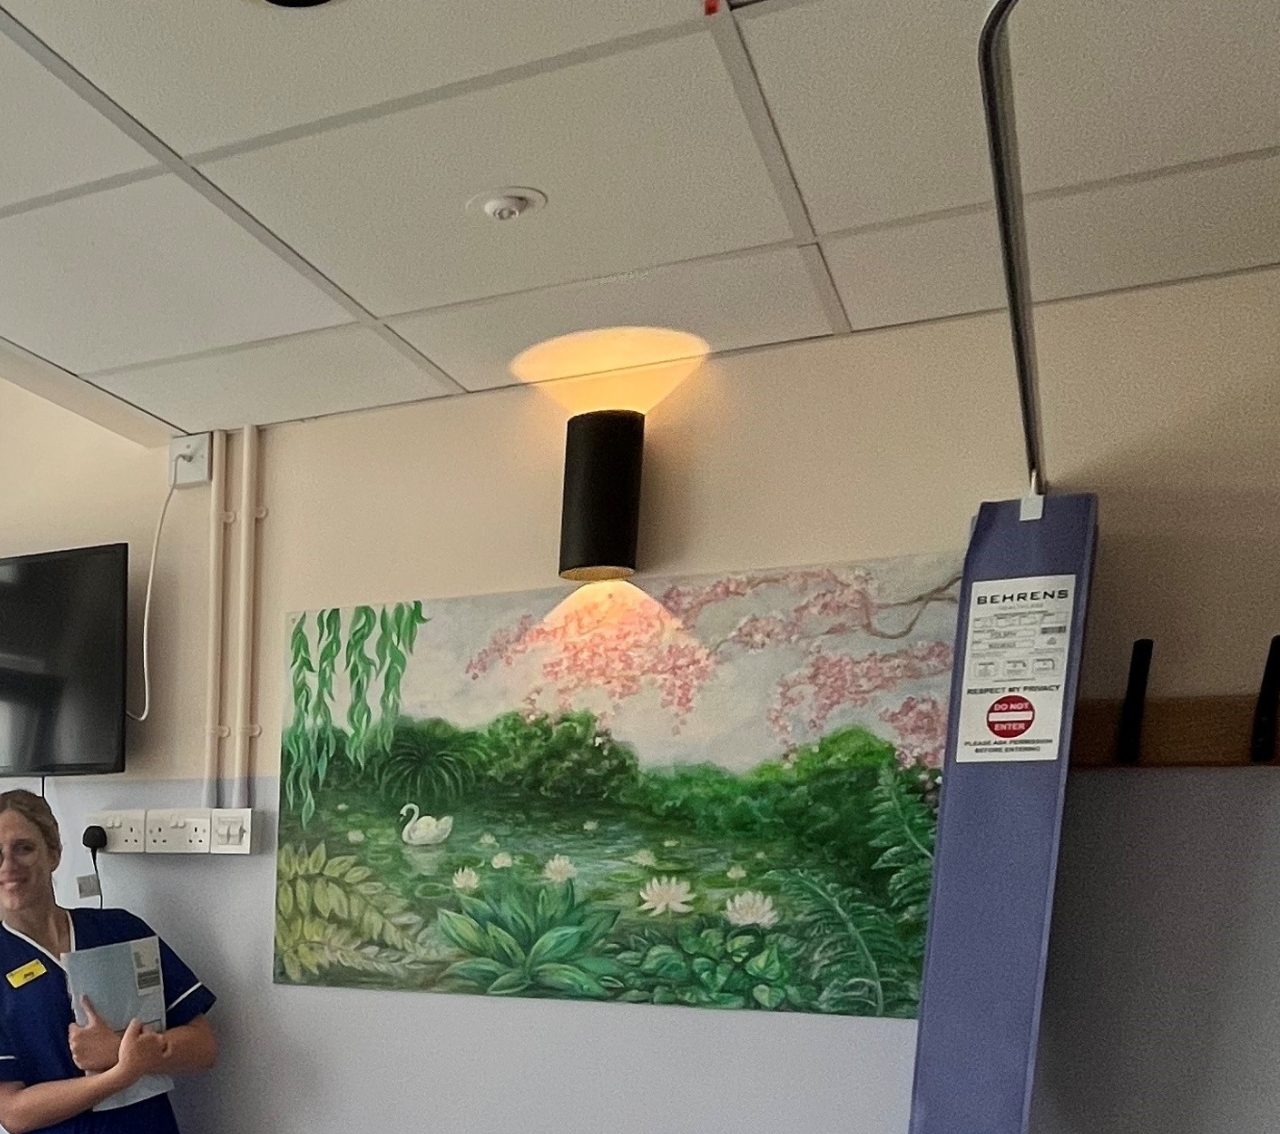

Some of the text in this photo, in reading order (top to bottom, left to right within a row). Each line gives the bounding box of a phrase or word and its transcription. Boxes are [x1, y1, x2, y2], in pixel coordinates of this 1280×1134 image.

[977, 590, 1069, 605] BEHRENS
[967, 687, 1006, 695] RESPECT
[994, 702, 1029, 711] DO NOT
[994, 723, 1025, 731] ENTER
